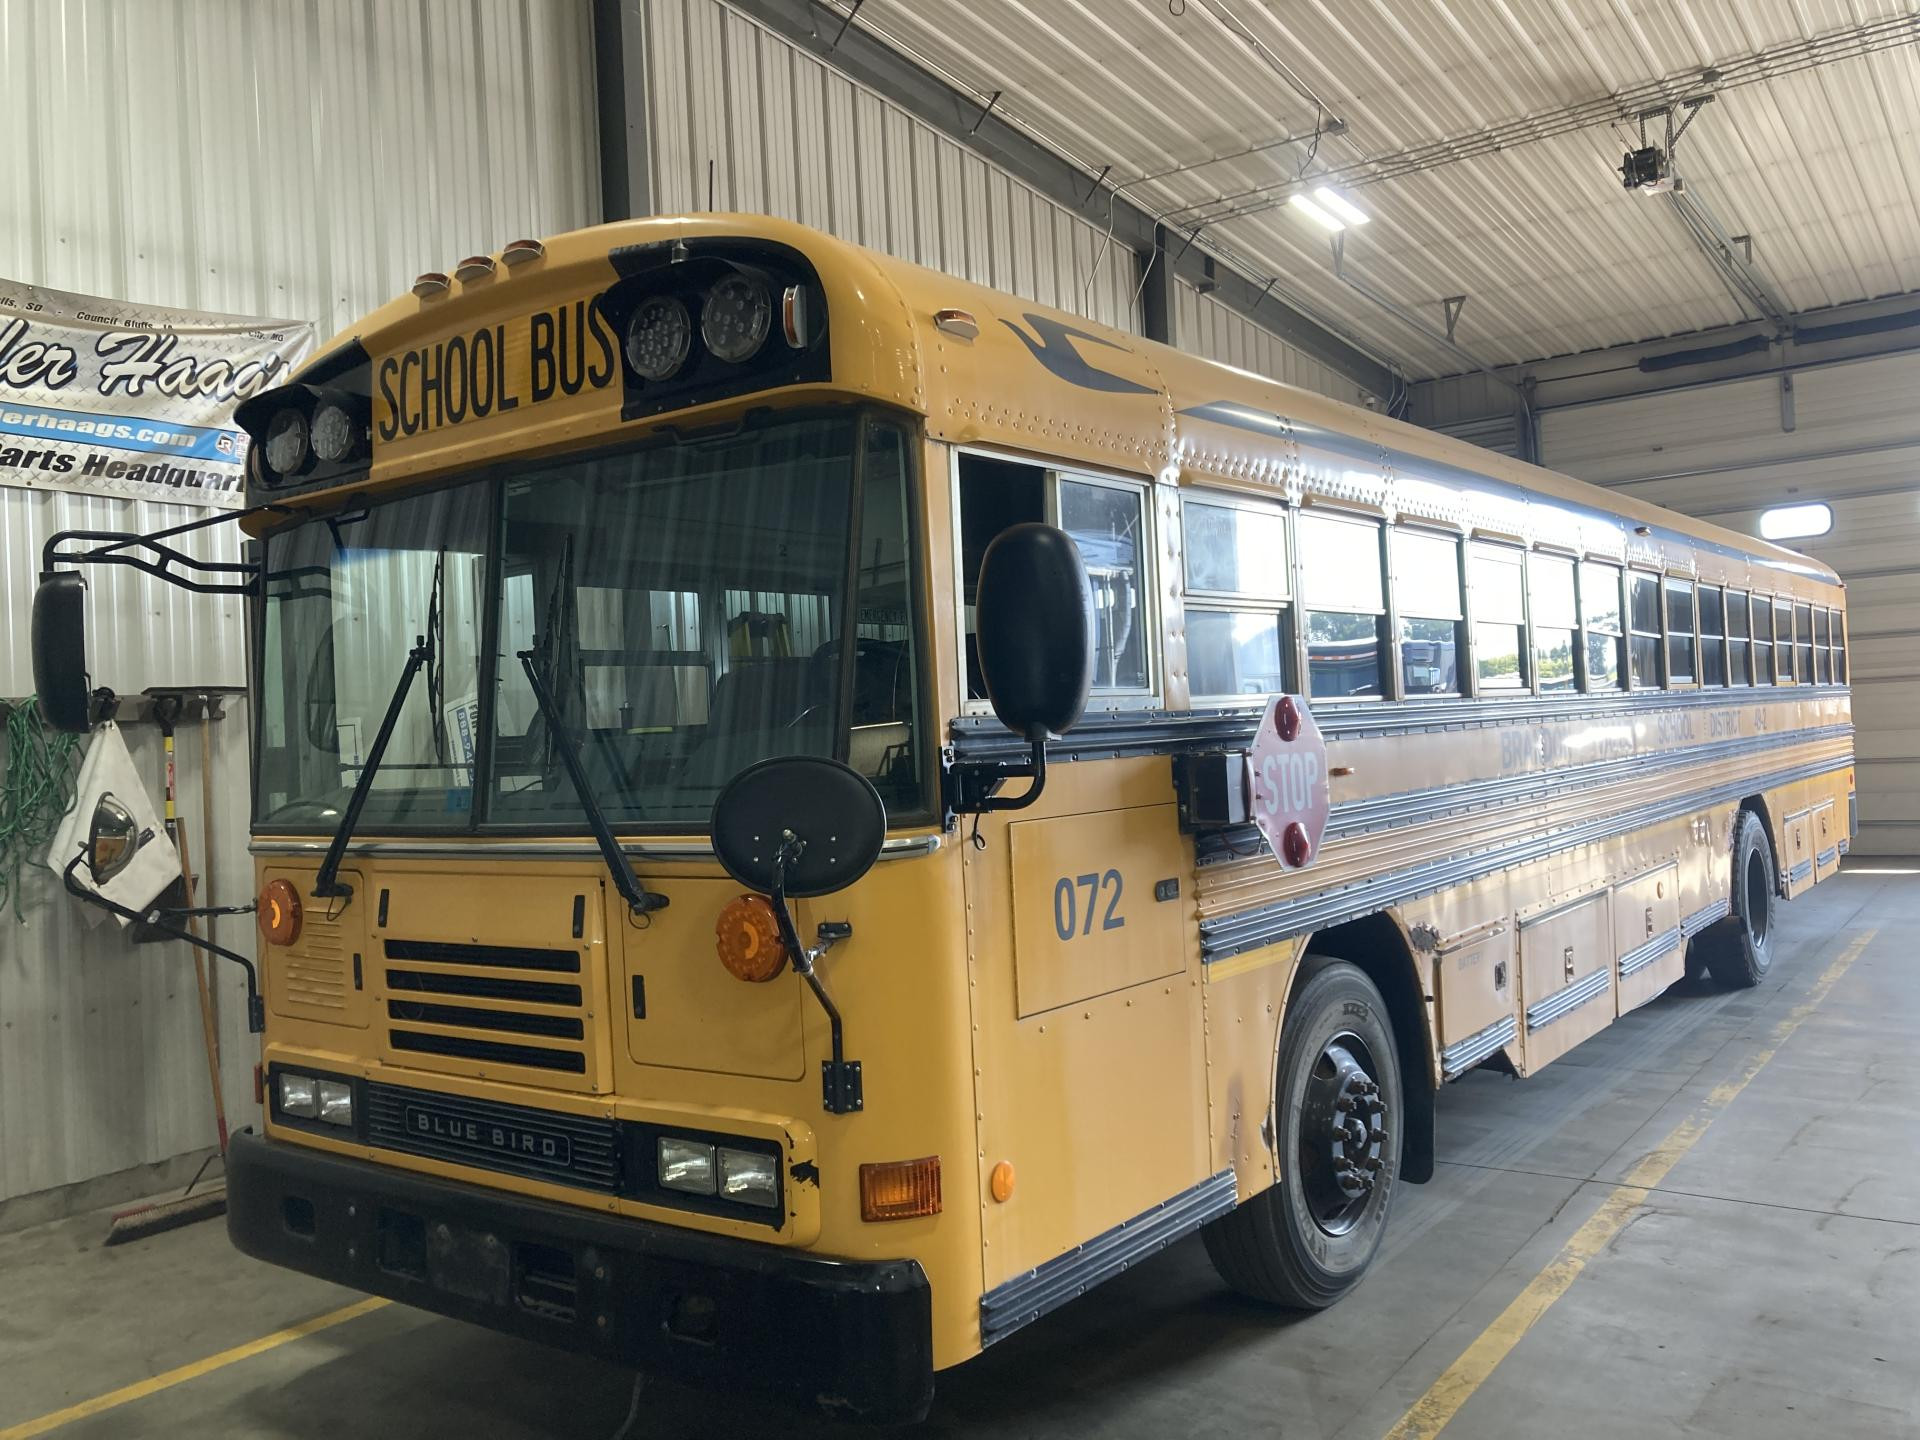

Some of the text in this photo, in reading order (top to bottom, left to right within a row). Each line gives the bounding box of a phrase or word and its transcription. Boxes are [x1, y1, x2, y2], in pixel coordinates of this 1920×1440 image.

[0, 296, 17, 308] lls,
[26, 302, 43, 312] SD
[76, 311, 118, 325] Council
[379, 293, 615, 442] SCHOOL BUS
[0, 407, 197, 448] erhaags.com
[0, 443, 76, 473] arts
[1657, 711, 1695, 745] SCHOOL
[1711, 709, 1741, 738] DISTRICT
[1262, 751, 1318, 816] STOP
[1054, 868, 1125, 941] 072
[418, 1113, 556, 1157] BLUE BIRD
